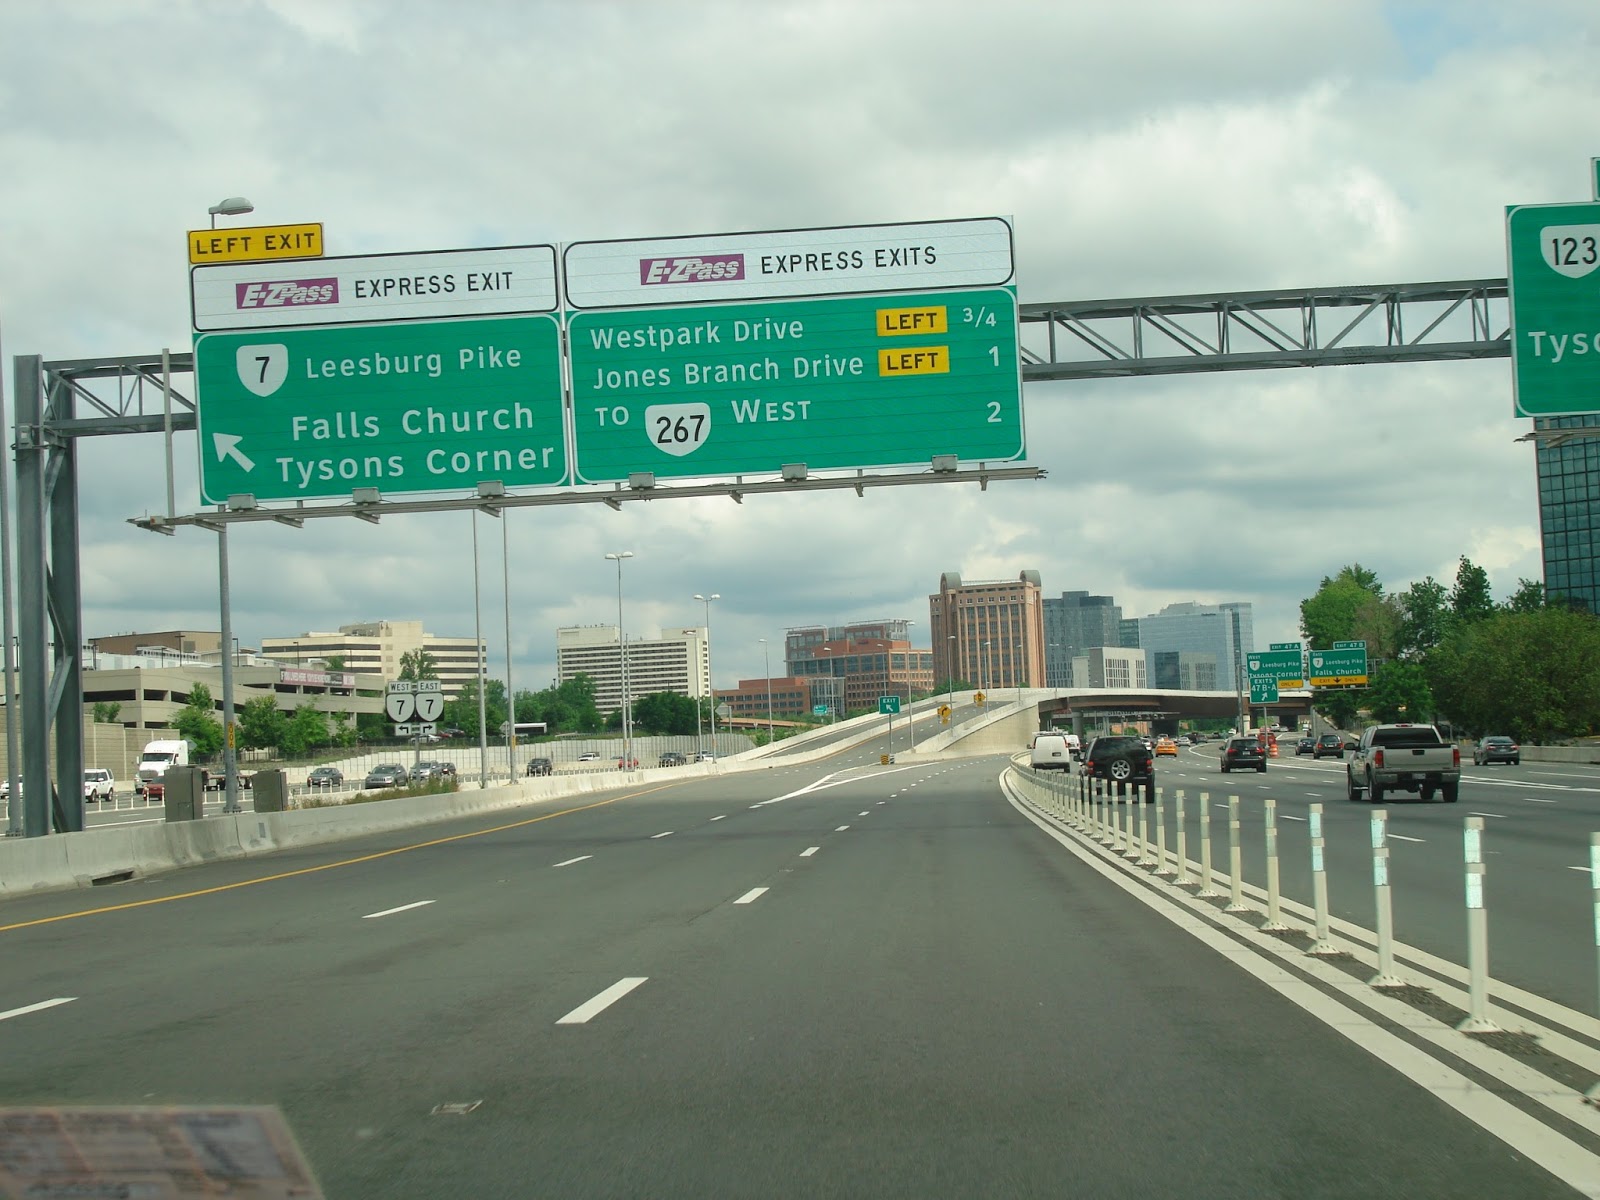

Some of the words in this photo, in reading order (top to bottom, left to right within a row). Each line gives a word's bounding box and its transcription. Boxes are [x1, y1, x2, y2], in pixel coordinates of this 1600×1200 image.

[196, 237, 252, 254] LEFT
[265, 232, 315, 251] EXIT
[1552, 236, 1598, 266] 123
[645, 258, 743, 285] E-ZPass
[761, 250, 864, 275] EXPRESS
[874, 245, 938, 269] EXITS
[241, 282, 337, 308] E-ZPass
[354, 274, 457, 299] EXPRESS
[466, 271, 514, 291] EXIT
[885, 312, 938, 331] LEFT
[962, 306, 998, 329] 3/4
[590, 321, 721, 352] Westpark
[734, 318, 805, 343] Drive
[306, 352, 443, 380] Leesburg
[458, 345, 522, 370] Pike
[886, 352, 939, 372] LEFT
[988, 346, 1000, 367] 1
[255, 356, 271, 384] 7
[593, 365, 672, 391] Jones
[684, 357, 780, 385] Branch
[793, 354, 865, 378] Drive
[292, 410, 381, 441] Falls
[401, 402, 534, 436] Church
[594, 405, 631, 427] TO
[730, 398, 812, 425] WEST
[986, 401, 1002, 424] 2
[655, 414, 706, 445] 267
[275, 452, 405, 489] Tysons
[425, 445, 555, 474] Corner
[390, 683, 410, 691] WEST
[420, 682, 438, 690] EAST
[1251, 684, 1261, 692] 47
[396, 699, 405, 715] 7
[425, 699, 434, 714] 7
